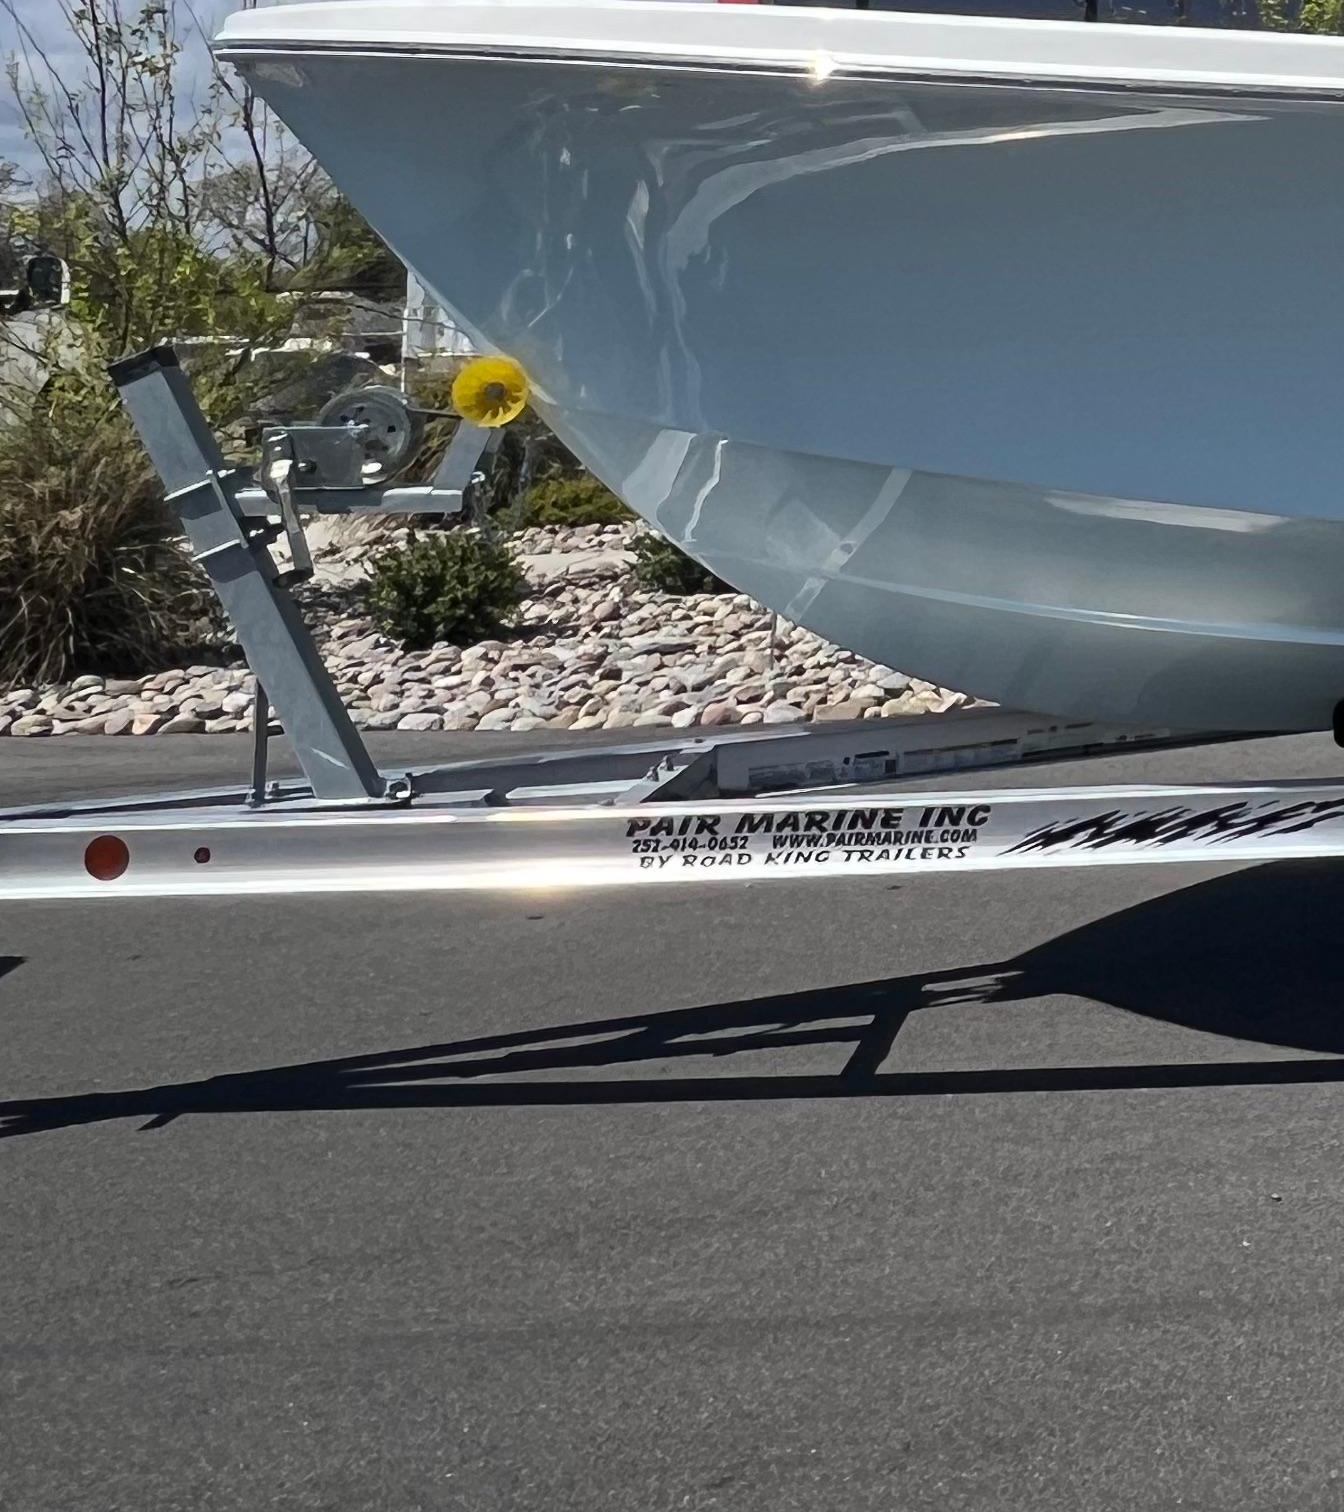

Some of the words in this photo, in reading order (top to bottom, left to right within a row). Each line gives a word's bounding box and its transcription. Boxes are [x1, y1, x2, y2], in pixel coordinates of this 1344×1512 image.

[626, 814, 721, 837] PAIR
[735, 807, 904, 834] MARINE
[918, 804, 991, 828] INC
[772, 829, 978, 849] WWW.PAIRMARINE.COM
[682, 853, 752, 867] ROAD
[764, 850, 830, 865] KING
[842, 846, 970, 862] TRAILERS
